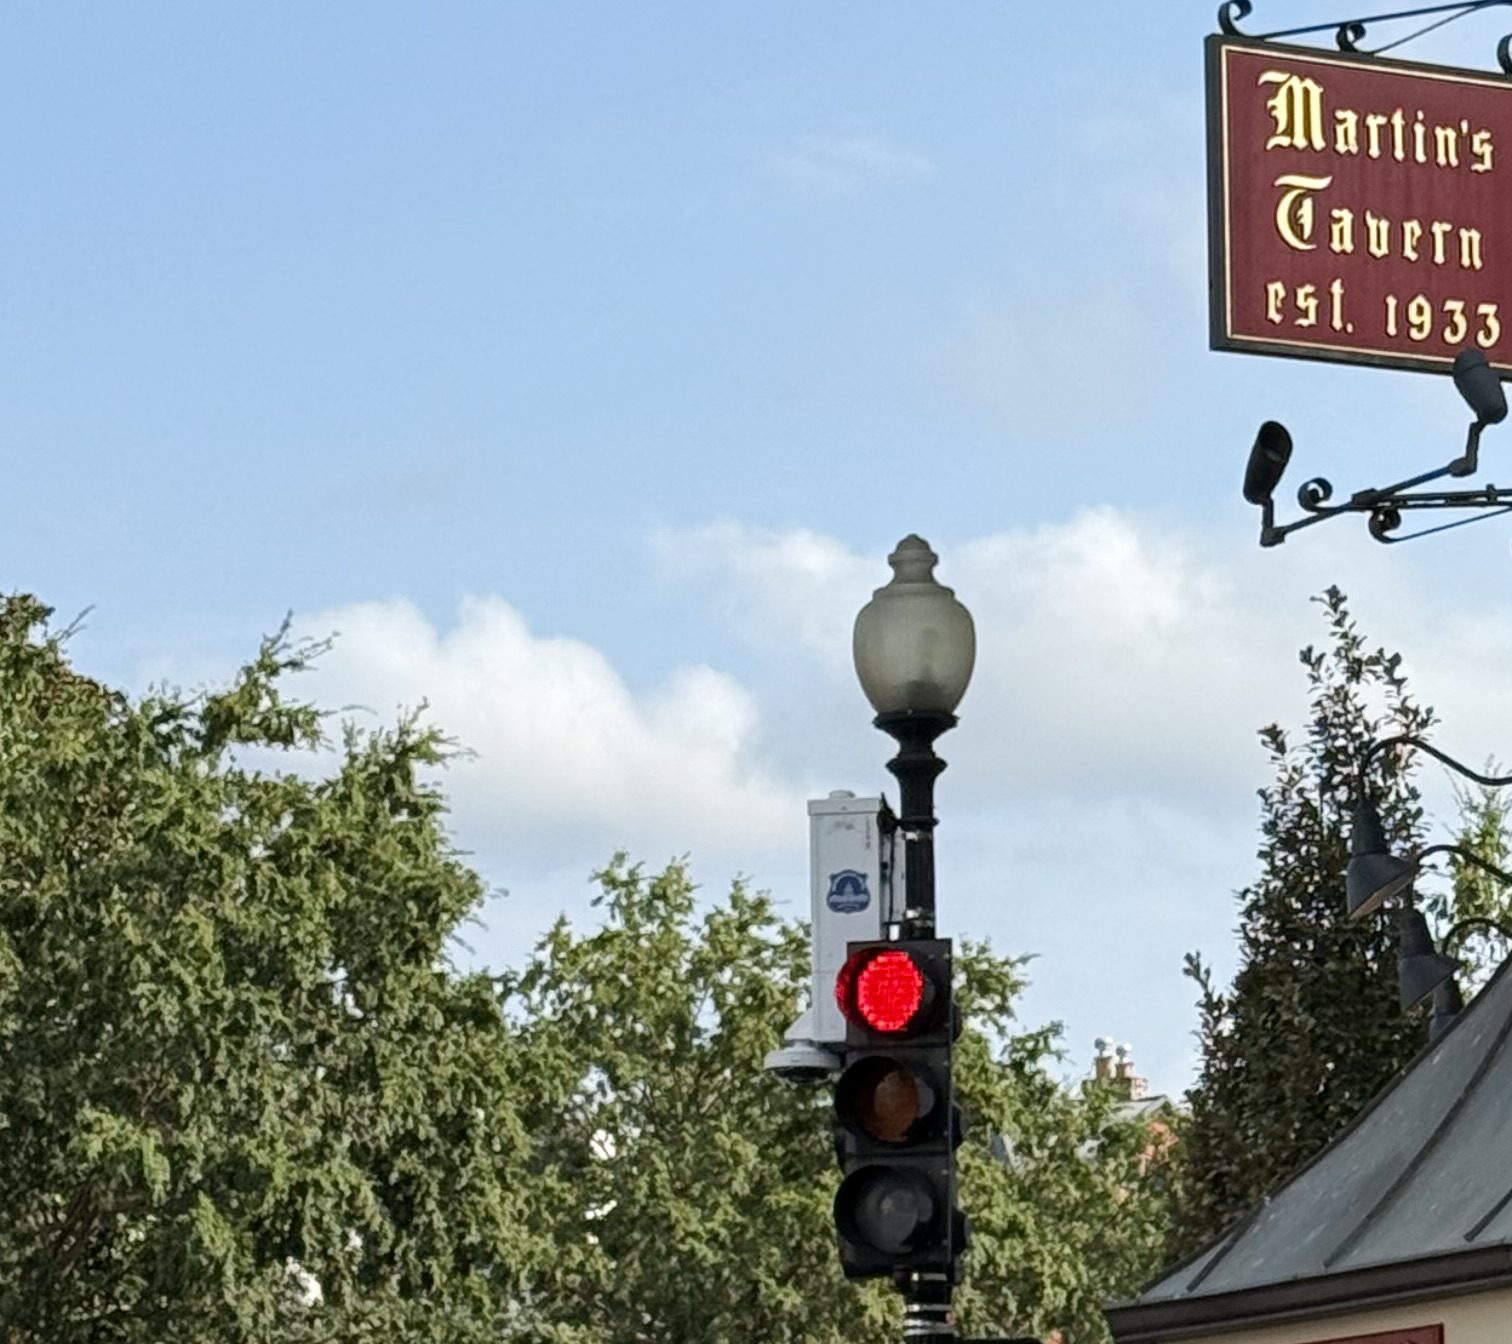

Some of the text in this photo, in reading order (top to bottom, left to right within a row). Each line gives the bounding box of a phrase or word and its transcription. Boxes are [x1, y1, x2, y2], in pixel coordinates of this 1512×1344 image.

[1257, 70, 1495, 172] Martin's
[1273, 174, 1484, 270] Tavern
[1265, 277, 1501, 348] est. 1933
